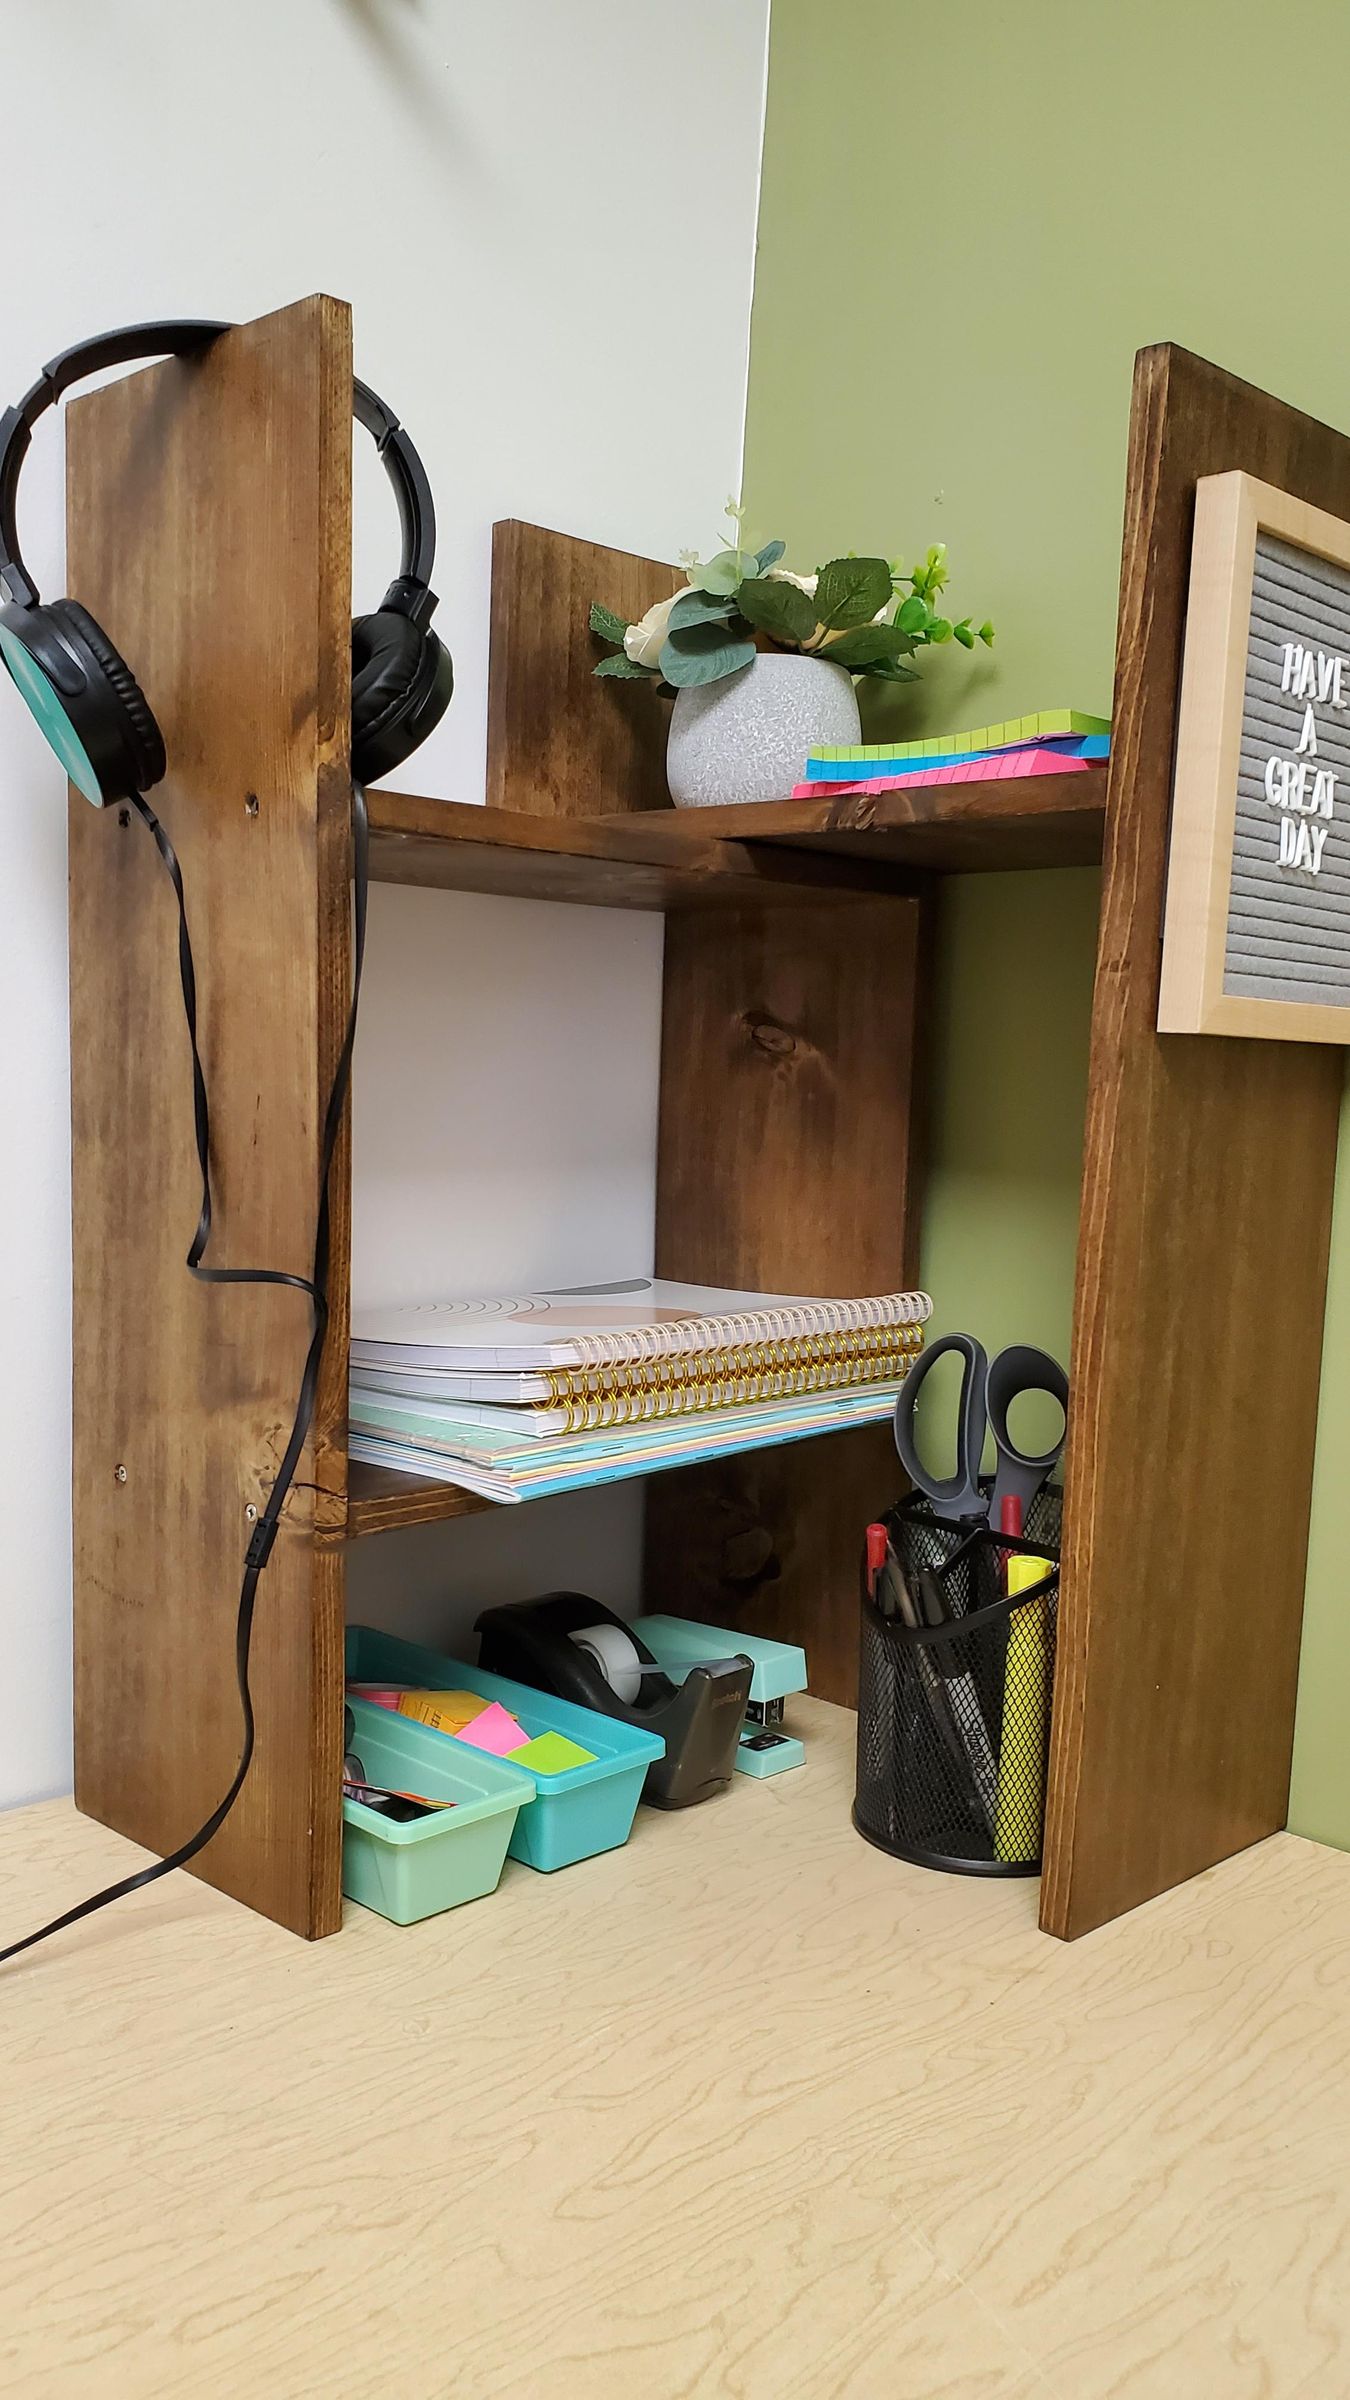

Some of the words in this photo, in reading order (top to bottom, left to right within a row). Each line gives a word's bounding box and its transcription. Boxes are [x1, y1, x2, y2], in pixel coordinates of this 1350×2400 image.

[1281, 642, 1350, 709] HAVE
[1294, 702, 1318, 757] A
[1265, 756, 1340, 820] GREAT
[1275, 816, 1329, 876] DAY
